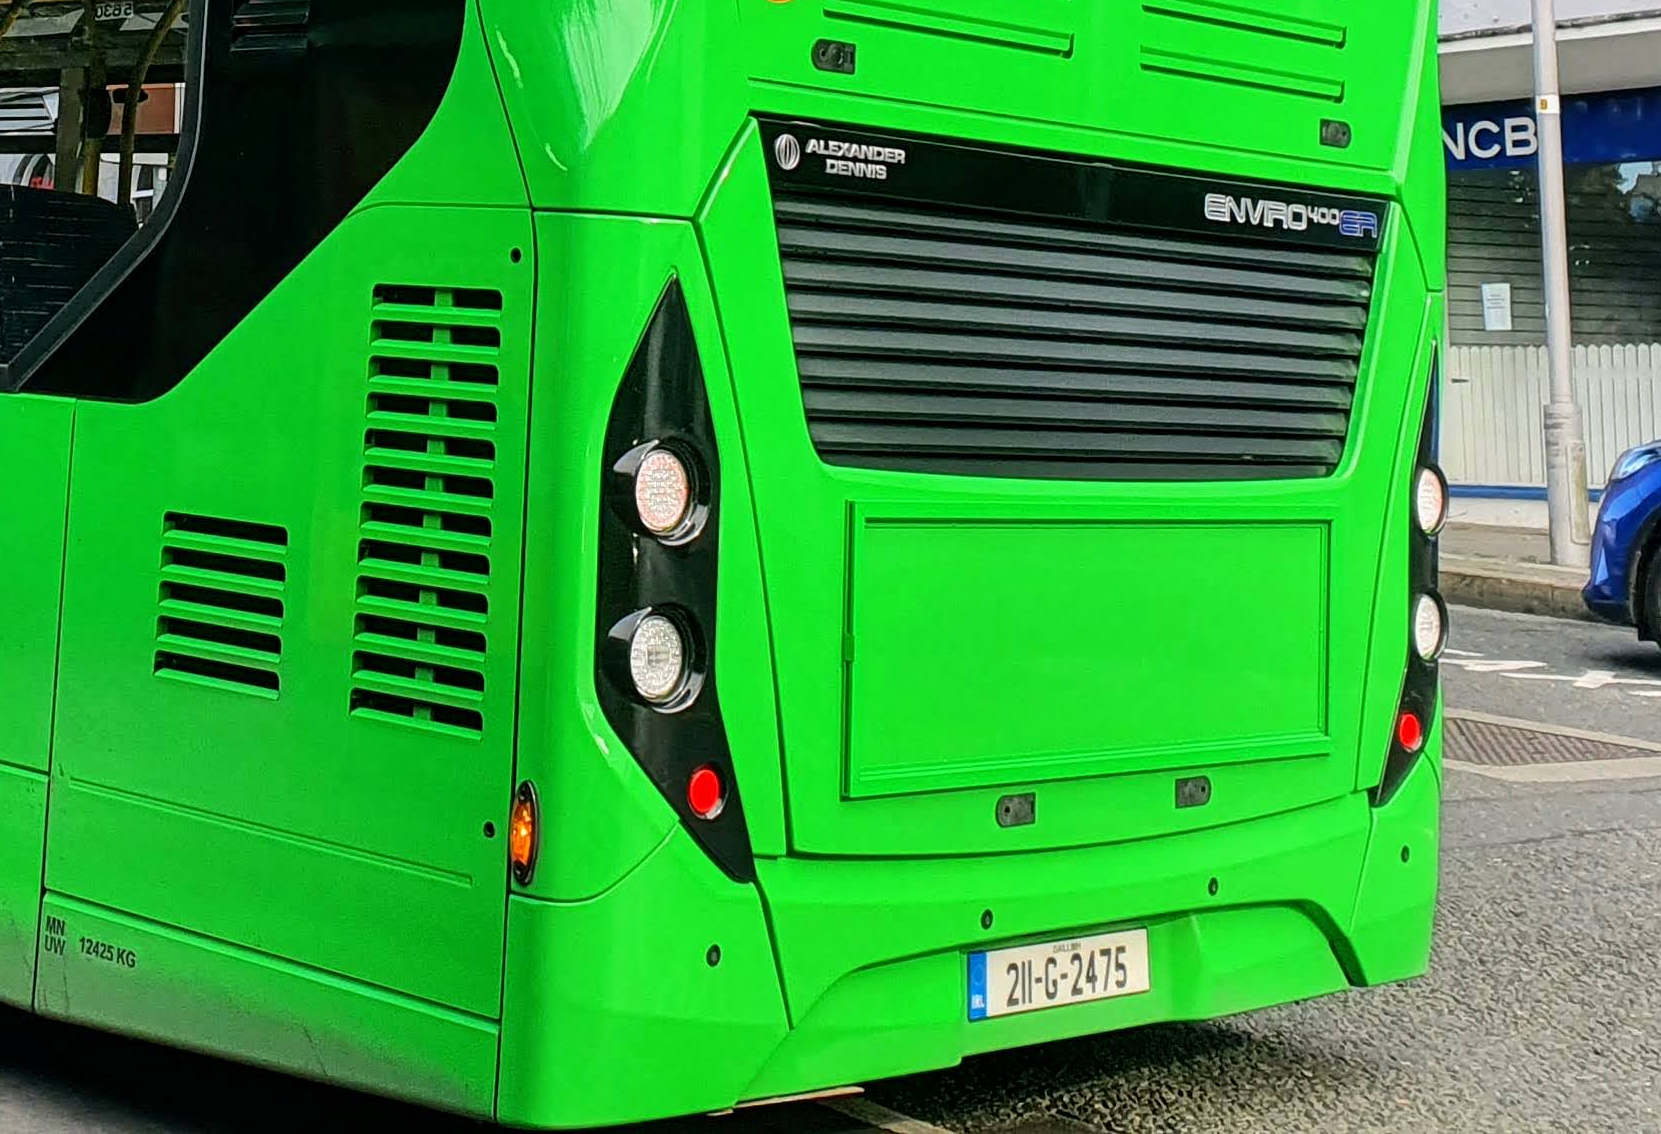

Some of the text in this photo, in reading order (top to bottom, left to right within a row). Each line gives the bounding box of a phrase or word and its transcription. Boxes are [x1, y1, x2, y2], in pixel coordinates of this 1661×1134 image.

[805, 138, 906, 165] ALEXANDER
[1441, 117, 1538, 160] NCB
[825, 158, 887, 179] DENNIS
[44, 935, 66, 956] UW
[79, 936, 136, 968] 12425 KG
[1007, 946, 1128, 1007] 211-G-2475
